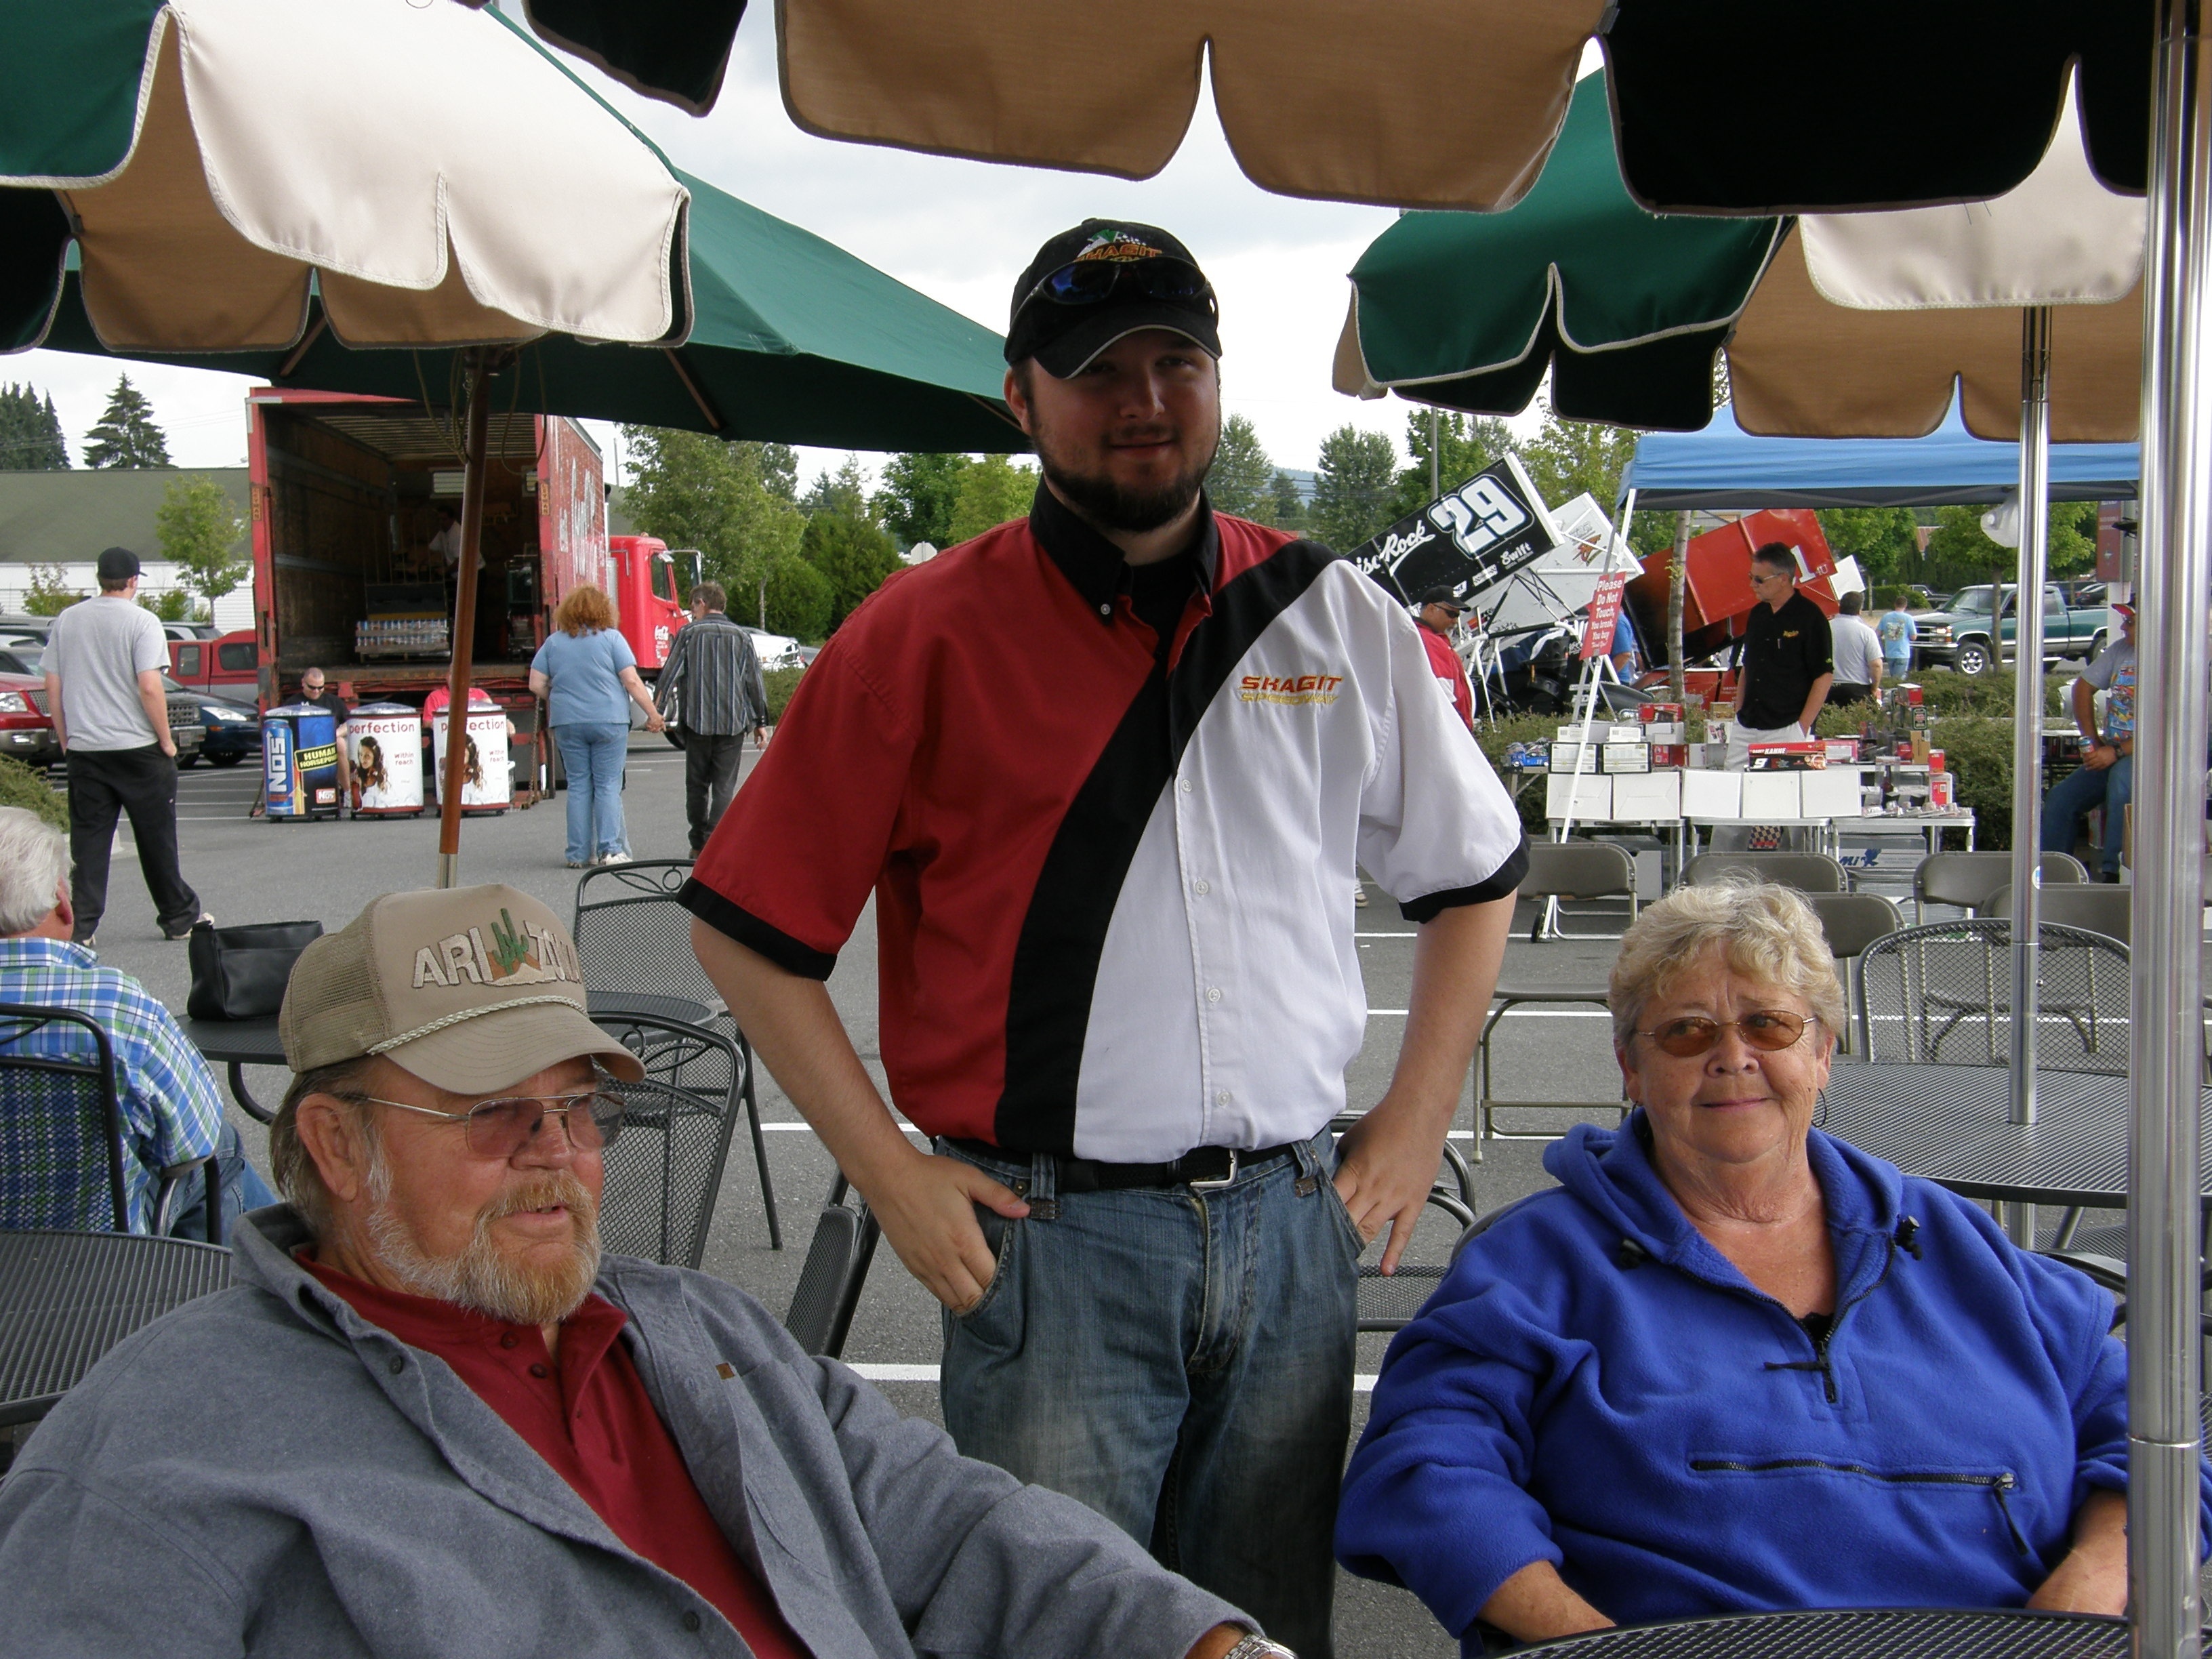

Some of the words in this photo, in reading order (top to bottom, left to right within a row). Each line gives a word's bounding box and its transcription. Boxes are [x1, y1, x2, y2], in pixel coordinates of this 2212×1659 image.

[1429, 475, 1530, 556] 29
[1597, 579, 1622, 592] Please
[1597, 594, 1605, 605] Do
[1606, 592, 1618, 603] Not
[1239, 675, 1343, 693] SKAGIT
[1241, 693, 1340, 705] SPEEDWAY
[349, 721, 415, 735] perfection
[441, 718, 505, 734] pection
[303, 746, 336, 761] HUMAN
[267, 736, 287, 792] NOS
[1753, 758, 1768, 769] 9
